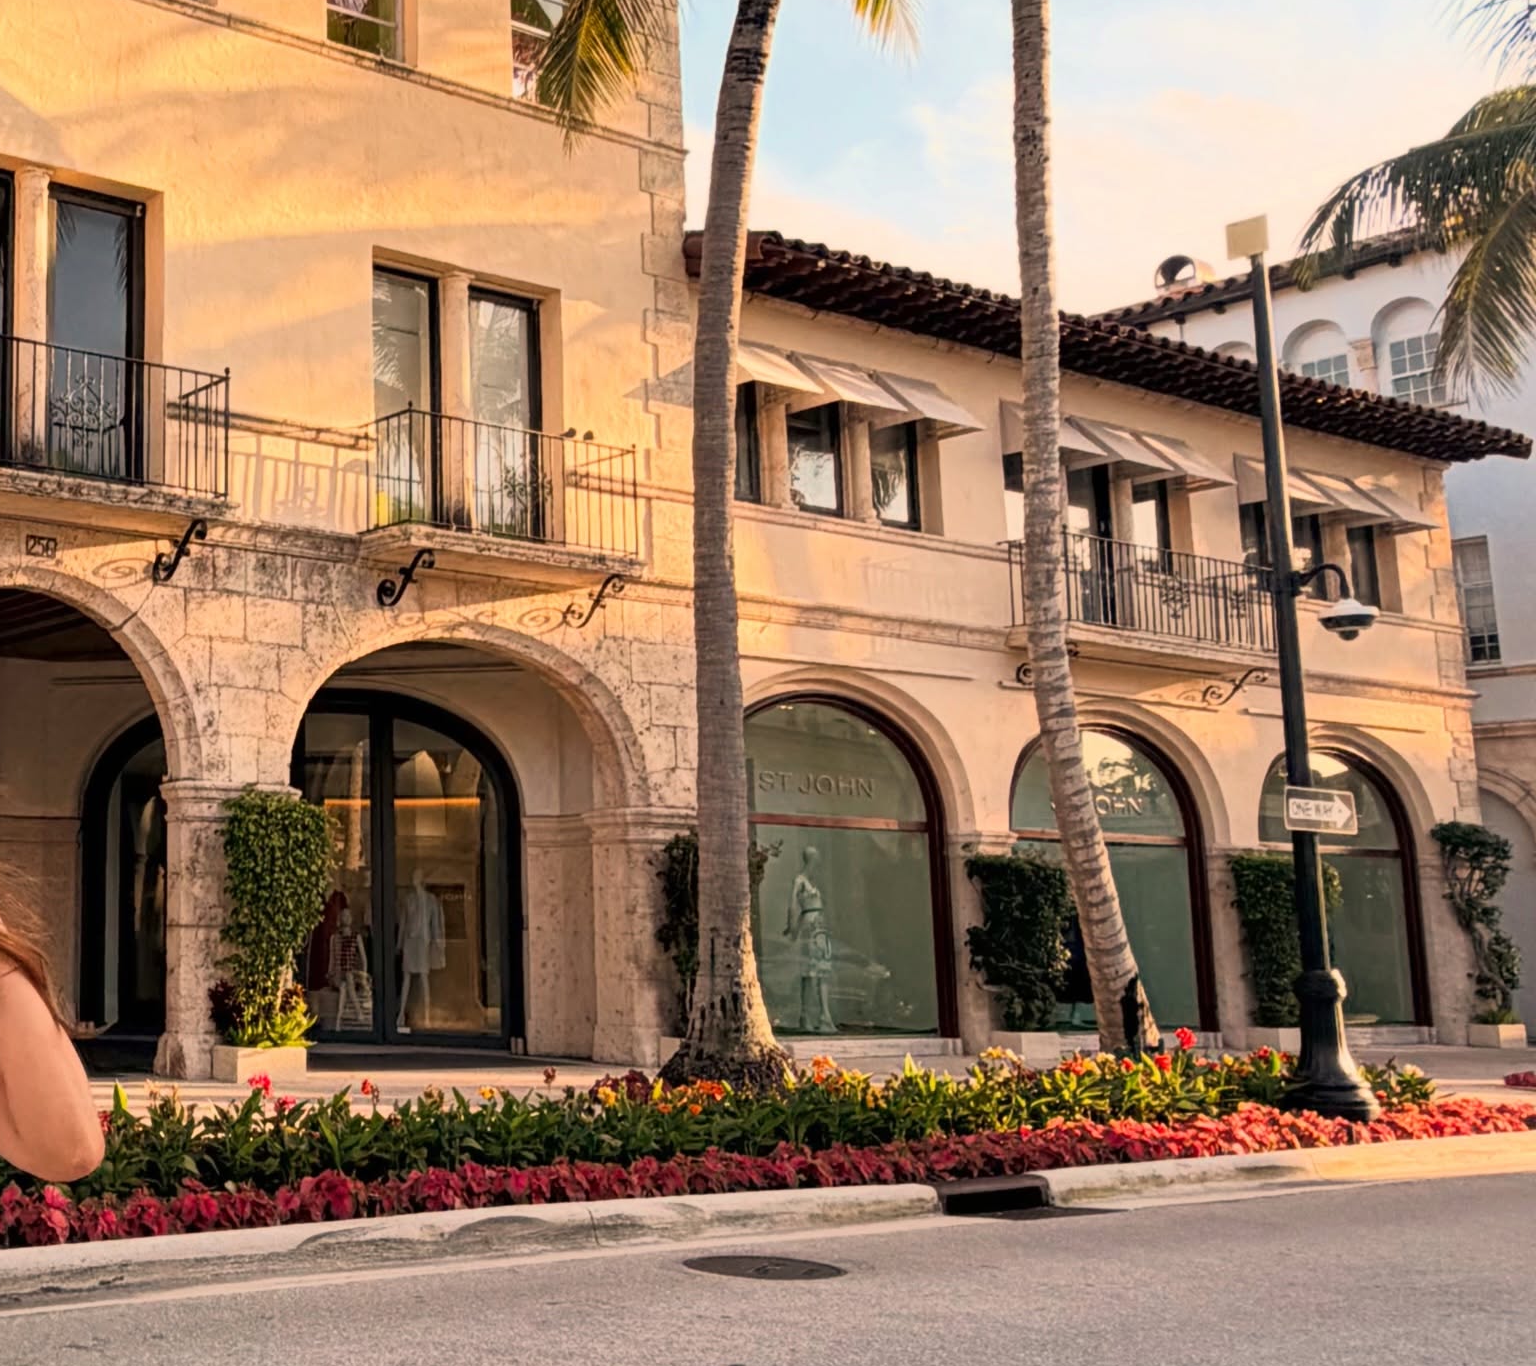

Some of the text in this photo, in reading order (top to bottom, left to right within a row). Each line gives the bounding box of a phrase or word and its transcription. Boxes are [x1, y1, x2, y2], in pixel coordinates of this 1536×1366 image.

[758, 771, 875, 799] ST JOHN
[1095, 795, 1143, 816] OHN
[1291, 801, 1335, 817] ONE WAY
